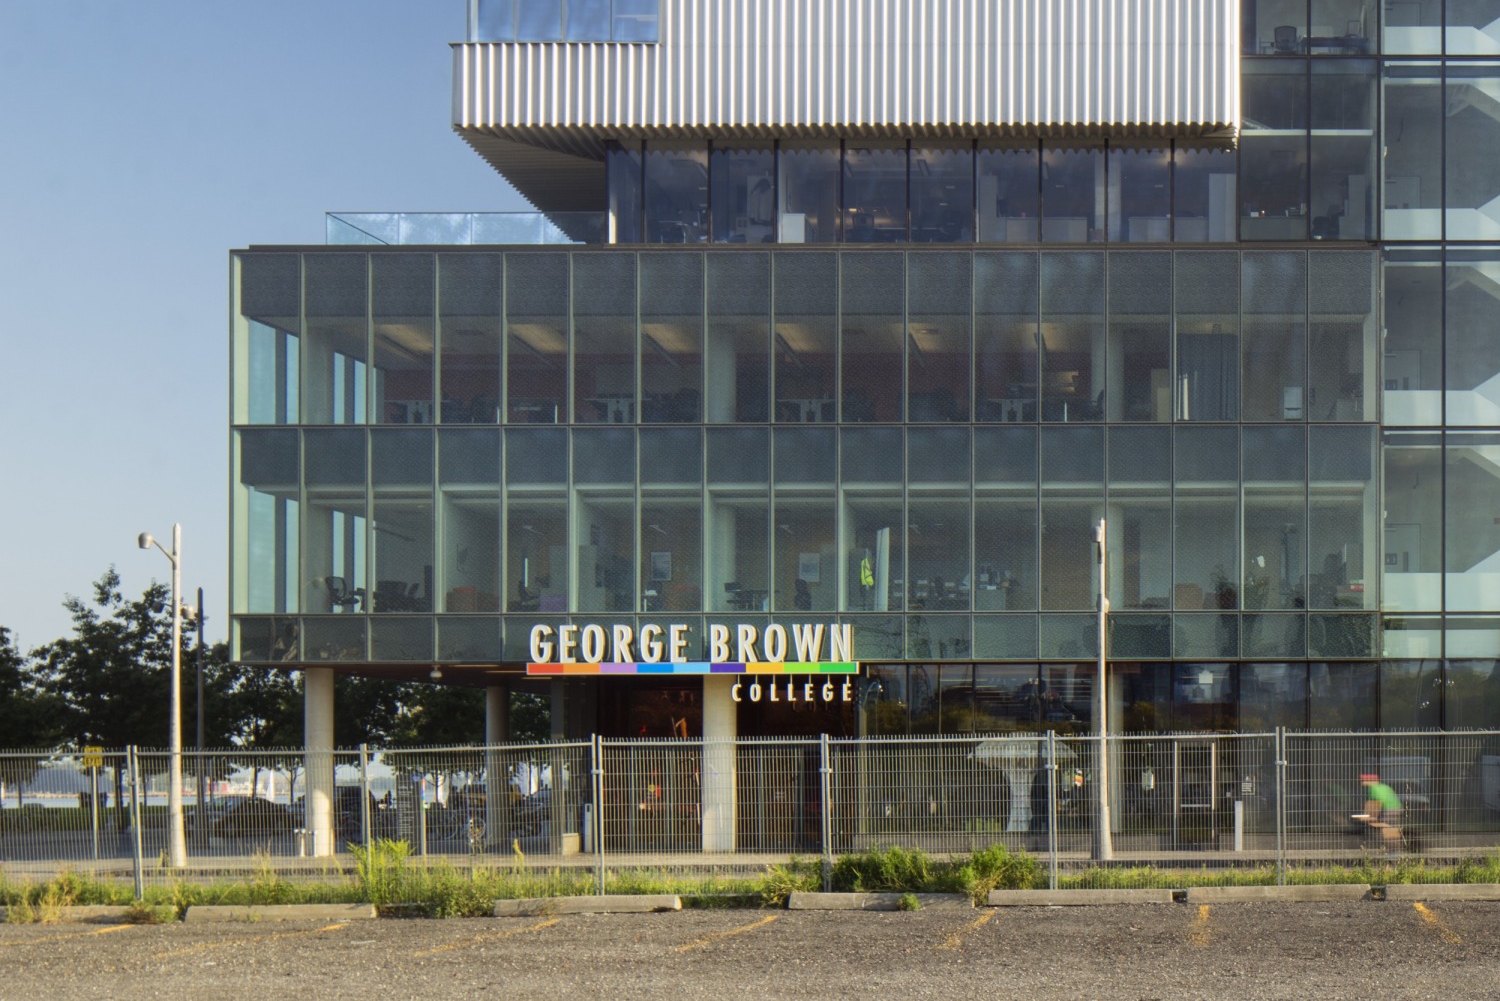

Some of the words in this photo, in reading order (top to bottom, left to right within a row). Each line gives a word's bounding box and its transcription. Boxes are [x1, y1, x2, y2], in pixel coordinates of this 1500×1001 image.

[530, 624, 688, 663] GEORGE
[710, 624, 851, 663] BROWN
[731, 683, 852, 701] COLLEGE
